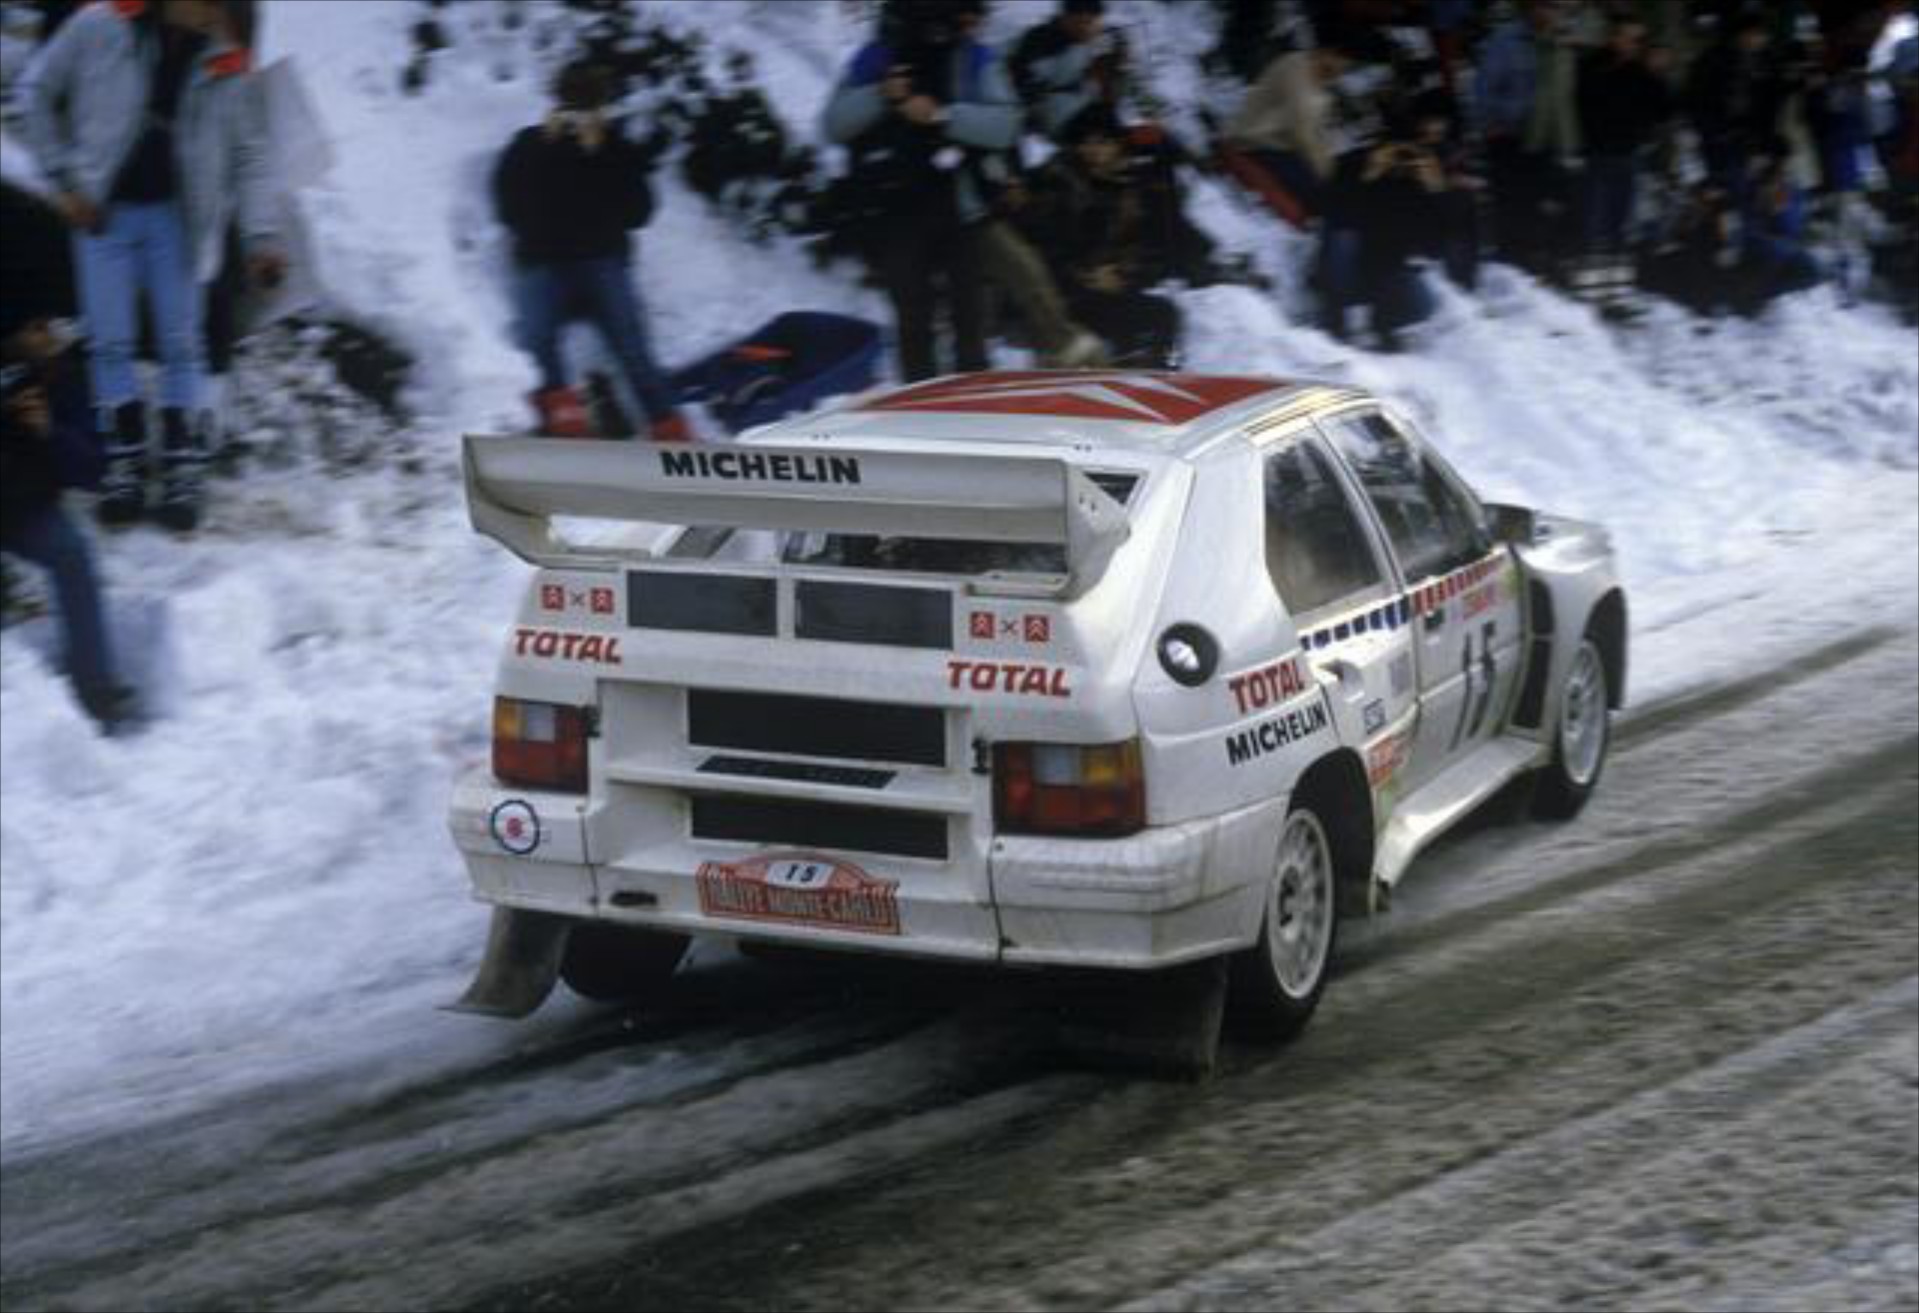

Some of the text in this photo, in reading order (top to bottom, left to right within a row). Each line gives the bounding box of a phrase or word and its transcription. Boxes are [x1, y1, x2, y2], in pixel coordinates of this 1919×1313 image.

[660, 452, 861, 483] MICHELIN
[515, 629, 622, 664] TOTAL
[948, 661, 1072, 697] TOTAL
[1229, 658, 1305, 714] TOTAL
[1449, 620, 1497, 753] 15
[1226, 701, 1327, 765] MICHELIN
[785, 864, 819, 882] 15
